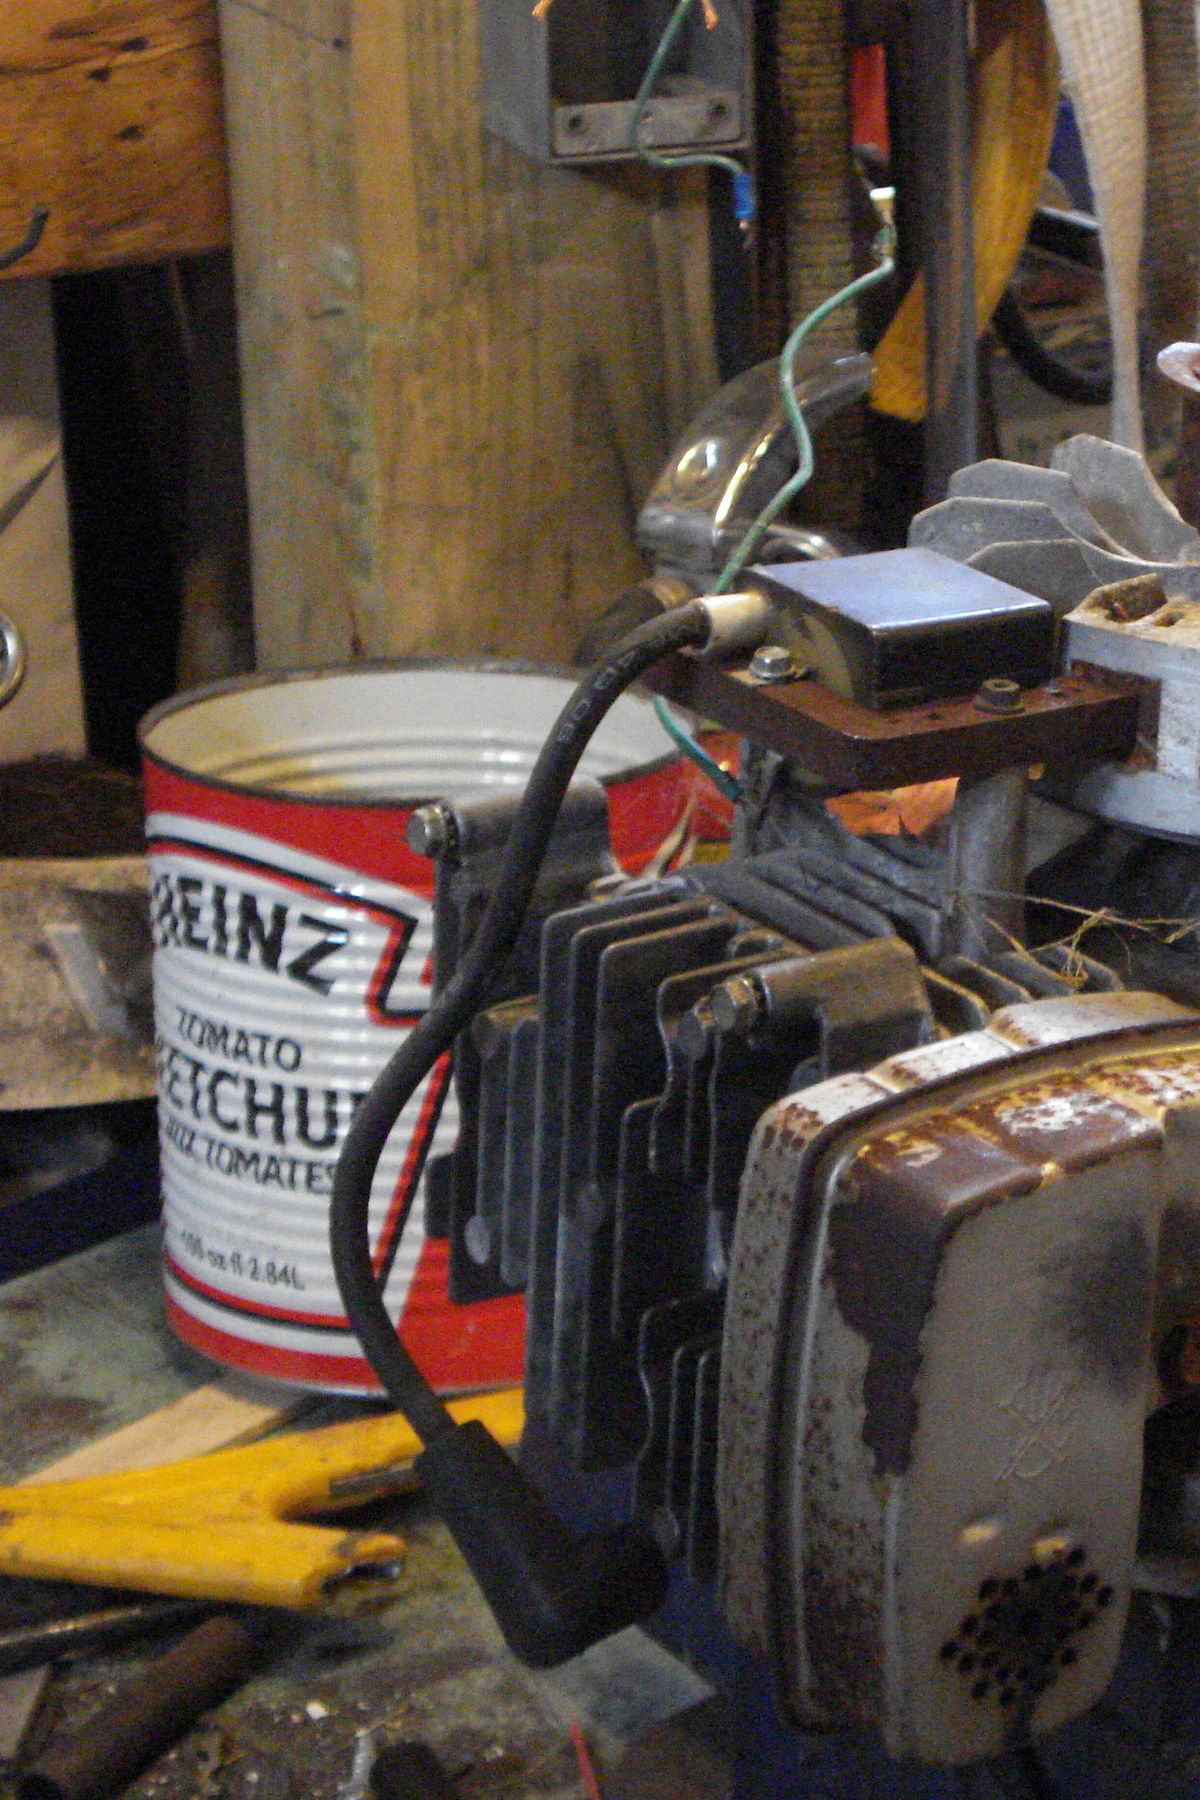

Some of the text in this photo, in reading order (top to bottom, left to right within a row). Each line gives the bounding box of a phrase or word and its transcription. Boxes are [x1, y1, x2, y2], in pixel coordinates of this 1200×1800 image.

[153, 873, 349, 996] HEINZ
[156, 1038, 366, 1150] KETCHU
[176, 1004, 302, 1072] TOMATO
